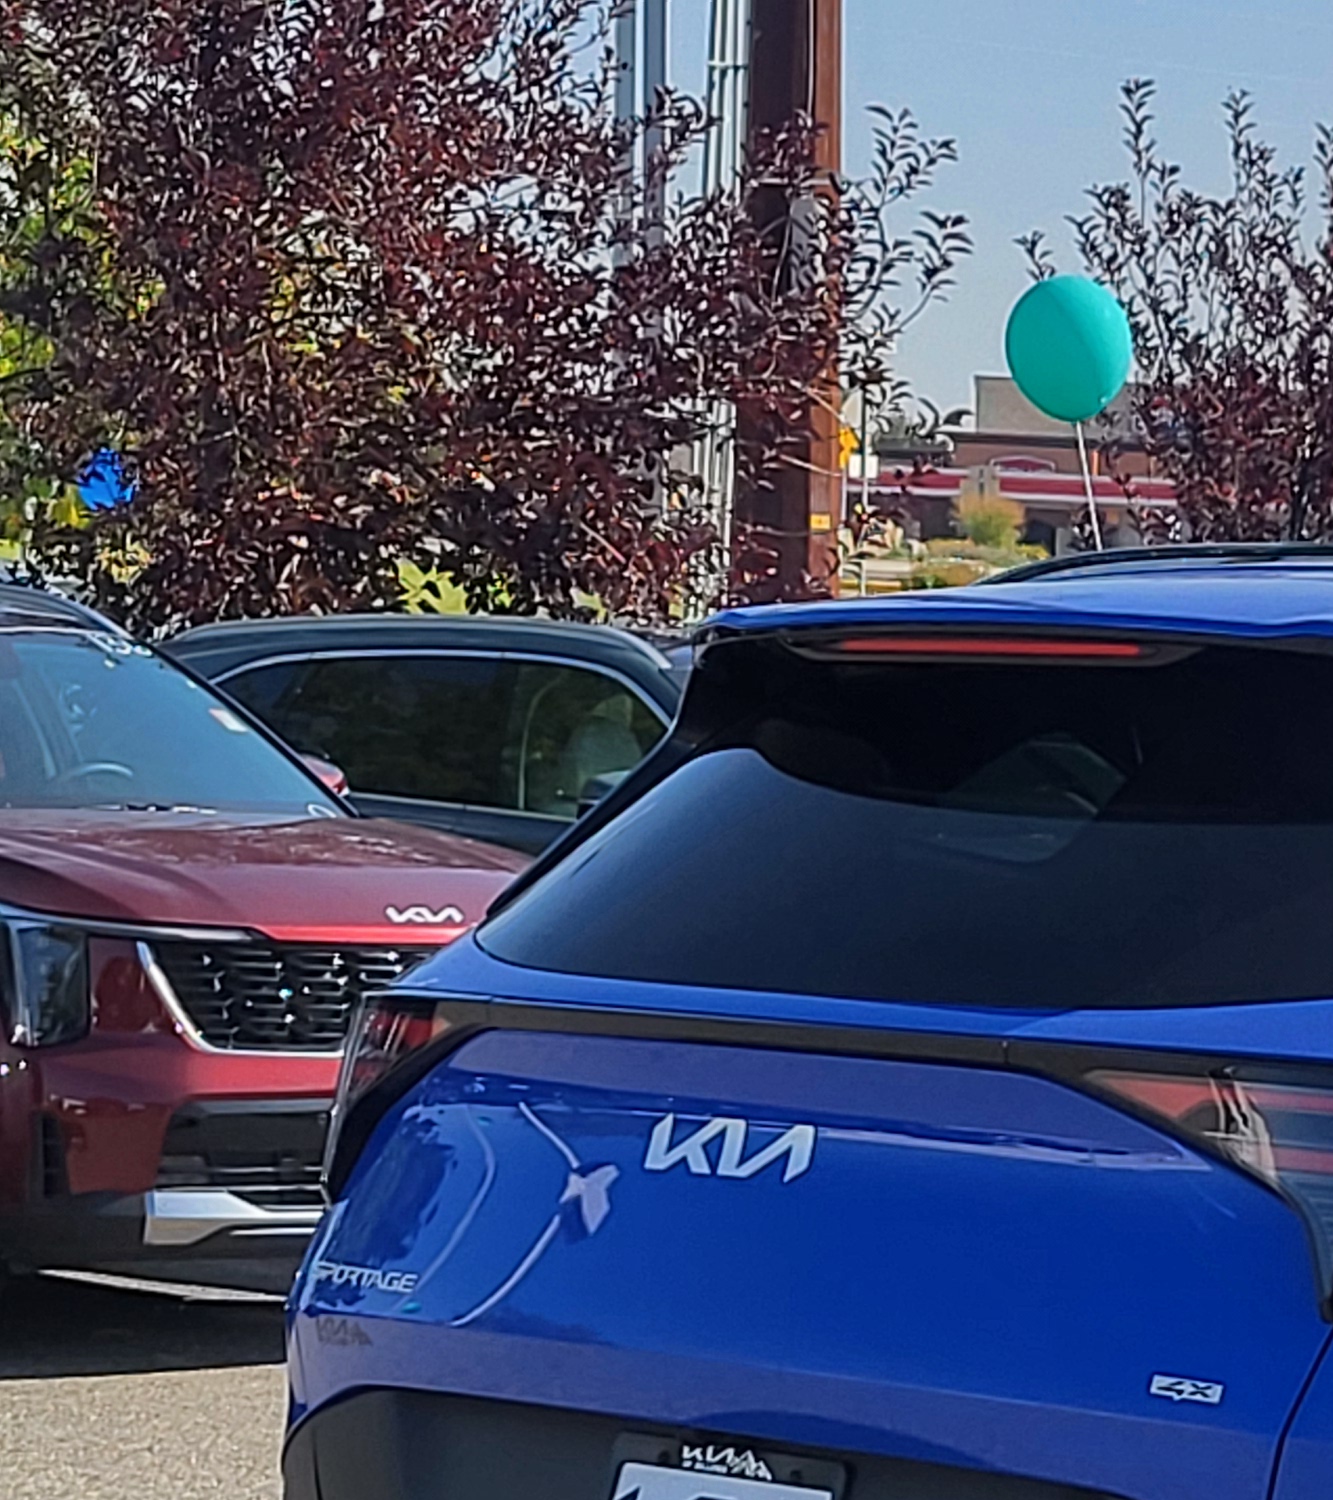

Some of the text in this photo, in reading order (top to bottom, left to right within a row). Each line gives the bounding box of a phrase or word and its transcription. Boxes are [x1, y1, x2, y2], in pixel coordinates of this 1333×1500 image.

[385, 906, 465, 924] KIA
[644, 1112, 816, 1184] KIA
[682, 1445, 736, 1467] KIA
